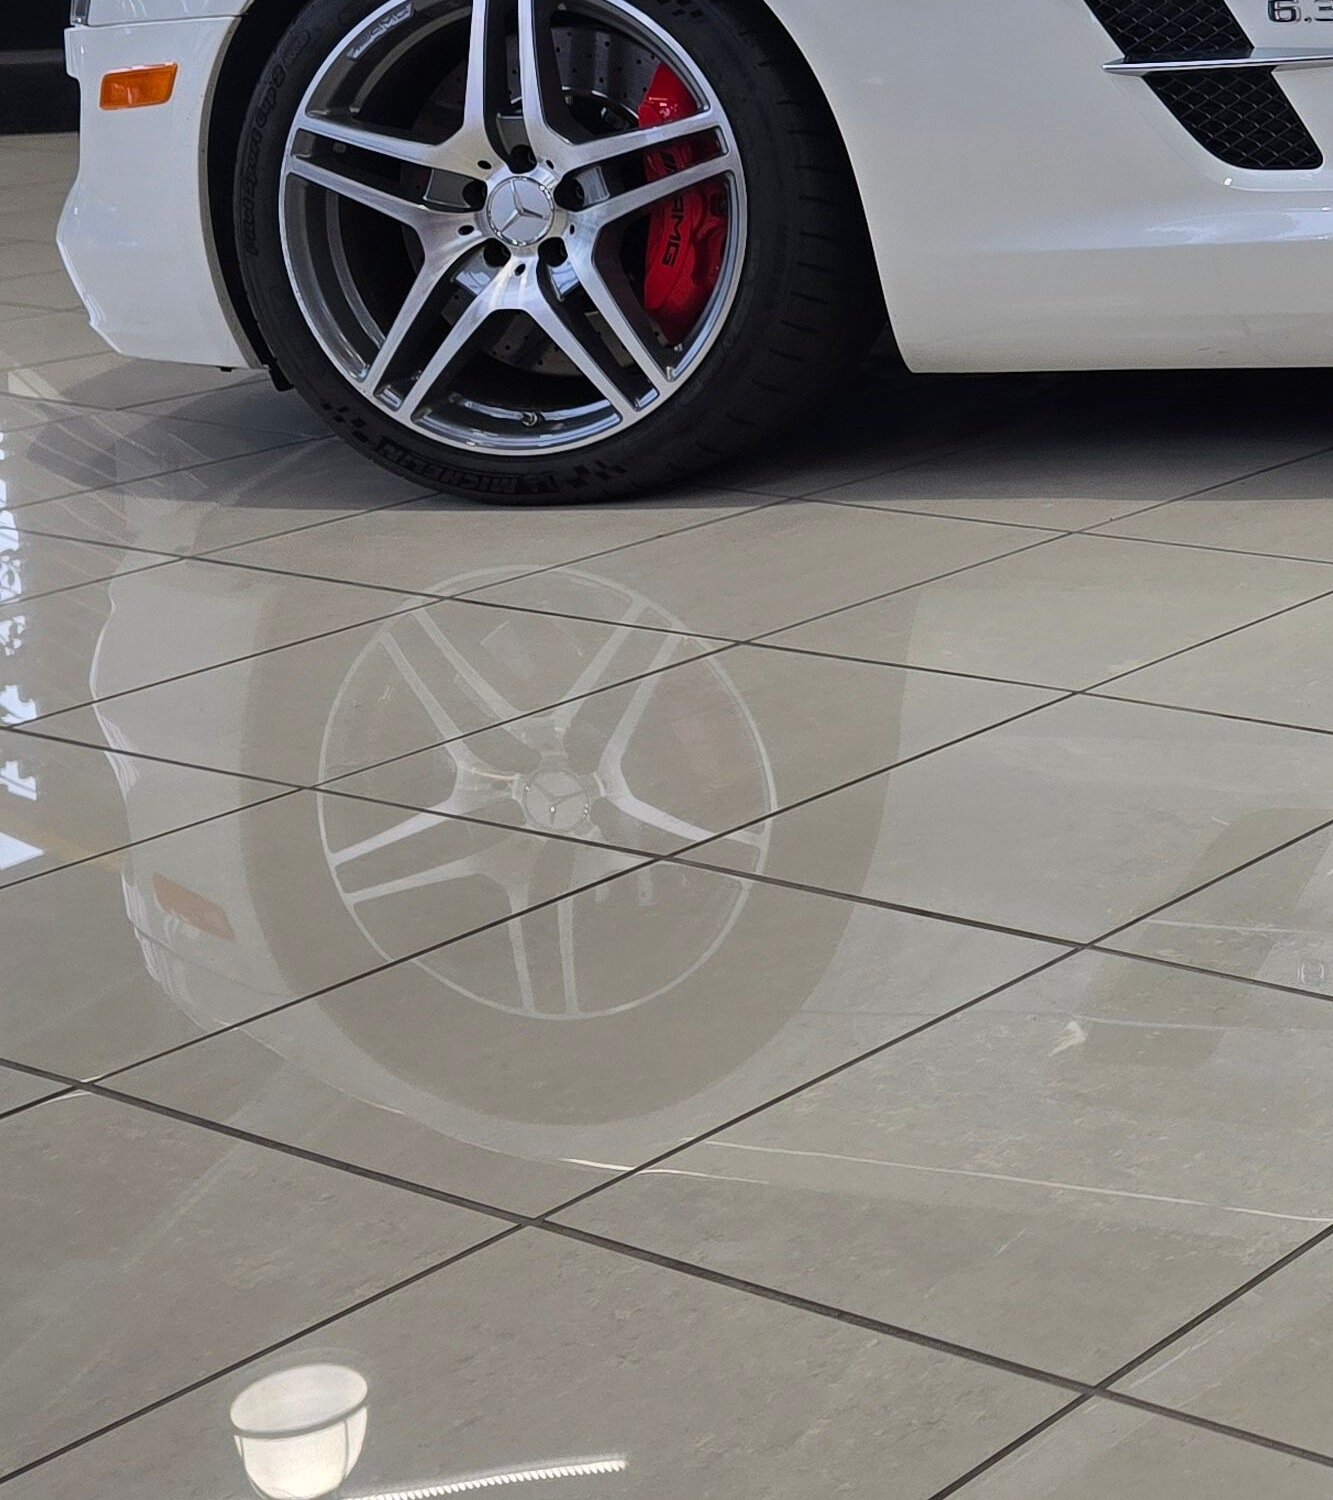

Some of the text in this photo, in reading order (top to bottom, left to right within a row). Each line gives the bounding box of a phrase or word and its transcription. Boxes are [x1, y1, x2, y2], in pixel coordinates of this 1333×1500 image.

[240, 128, 264, 197] Sport
[255, 86, 279, 129] Cup
[376, 442, 519, 494] MICHELIN
